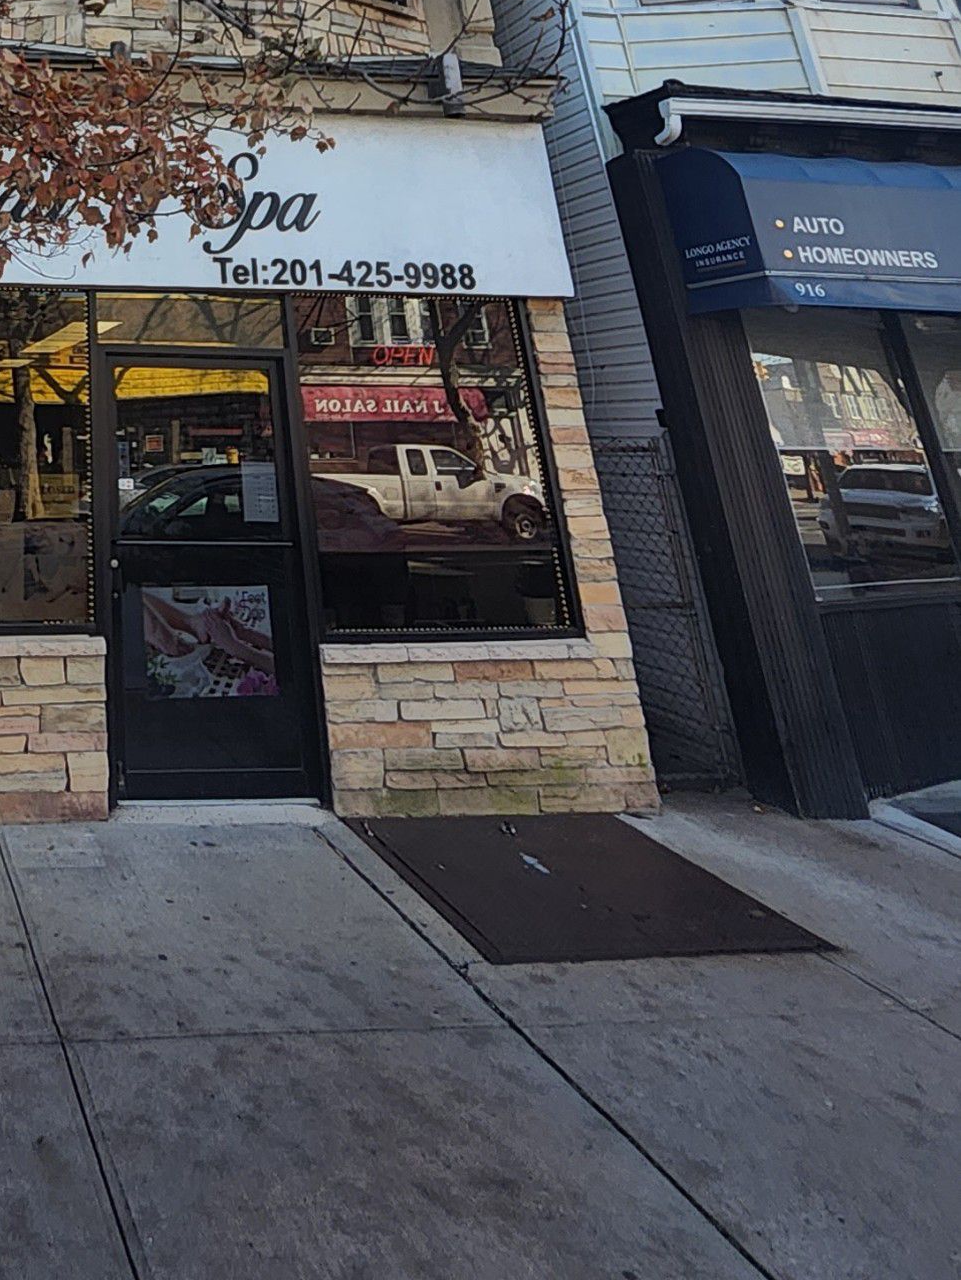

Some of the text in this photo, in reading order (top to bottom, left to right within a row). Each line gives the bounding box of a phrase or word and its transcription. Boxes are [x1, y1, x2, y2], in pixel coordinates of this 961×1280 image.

[190, 151, 322, 255] Spa
[792, 216, 844, 235] AUTO
[684, 235, 750, 259] LONGO AGENCY
[797, 245, 938, 269] HOMEOWNERS
[695, 250, 745, 268] INSURANCE
[212, 257, 477, 290] Tel:201-425-9988
[794, 282, 826, 298] 916
[373, 345, 435, 366] OPEN
